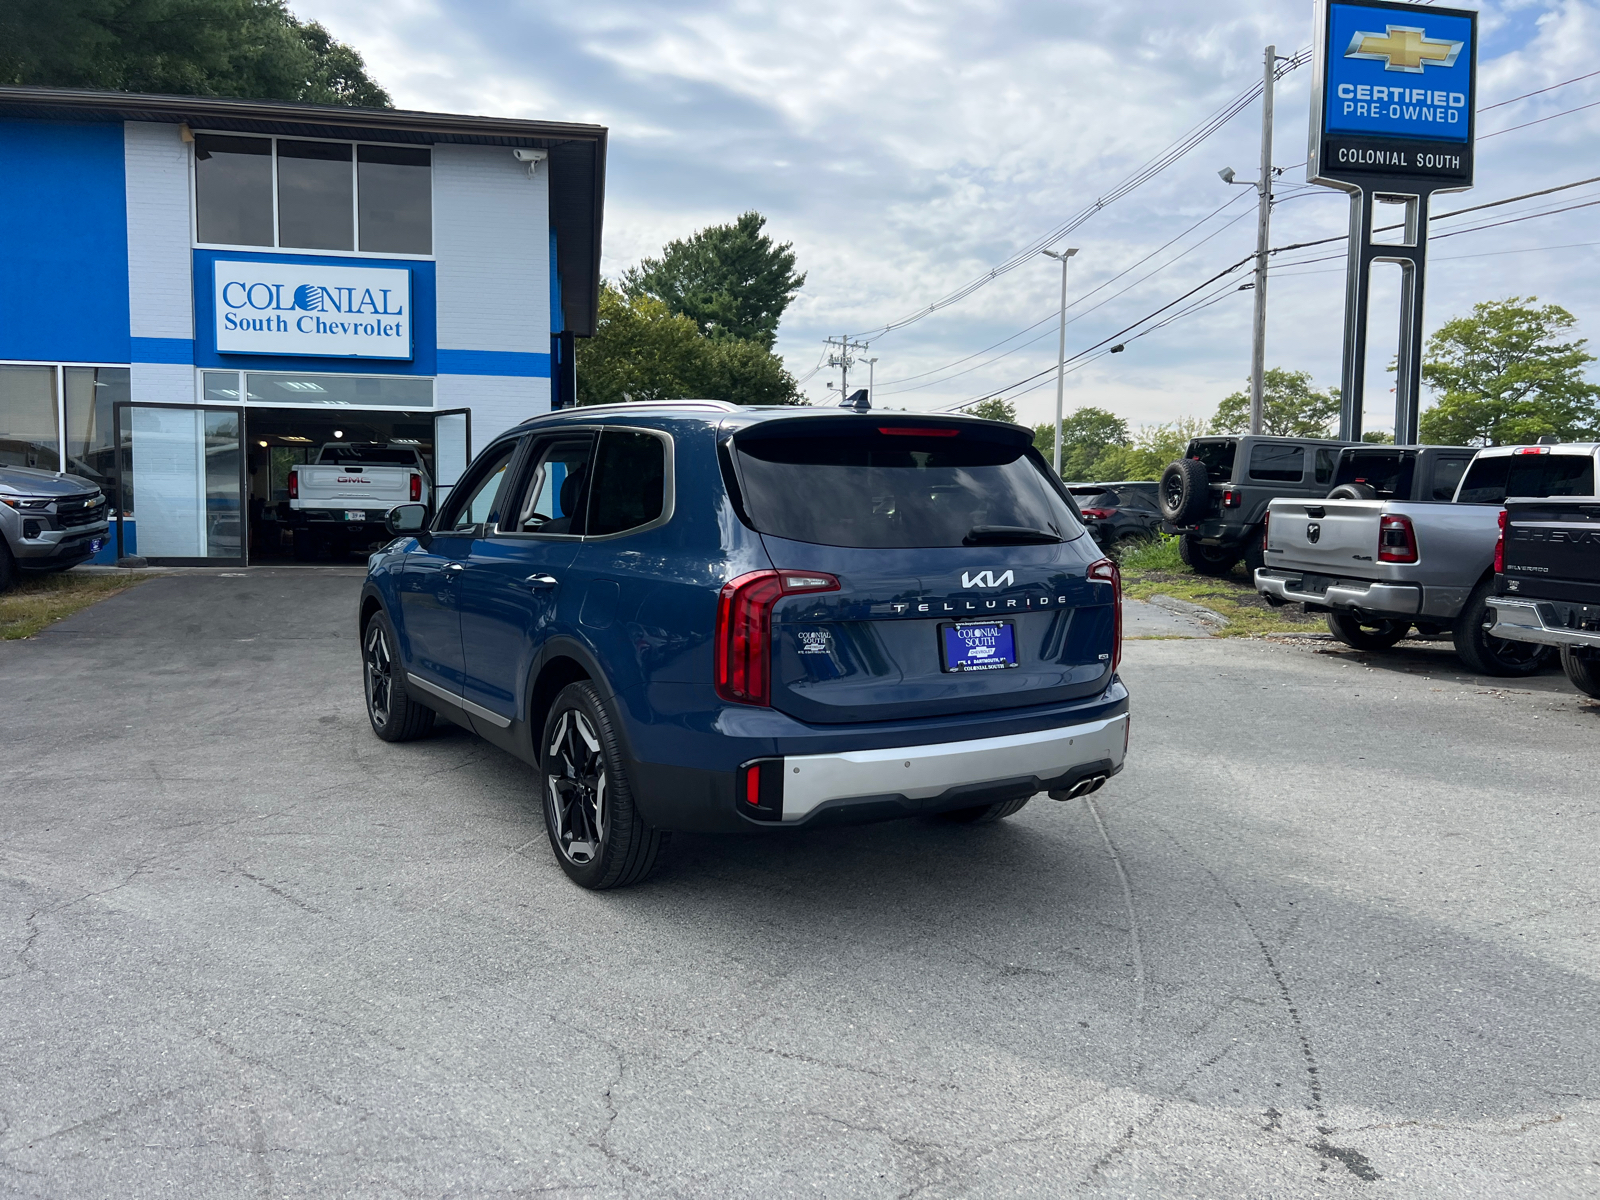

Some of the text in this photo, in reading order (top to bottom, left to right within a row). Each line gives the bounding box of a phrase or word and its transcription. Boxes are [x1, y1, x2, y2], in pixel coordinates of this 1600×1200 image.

[1337, 83, 1465, 108] CERTIFIED
[1343, 101, 1458, 123] PRE-OWNED
[1338, 148, 1460, 169] COLONIAL SOUTH
[222, 281, 402, 315] COLONIAL
[224, 312, 403, 336] South Chevrolet
[1507, 564, 1549, 573] SILVERADO
[894, 595, 1067, 613] TELLURIDE
[797, 631, 832, 639] COLONIAL
[958, 628, 1001, 638] COLONIAL
[965, 637, 995, 647] SOUTH
